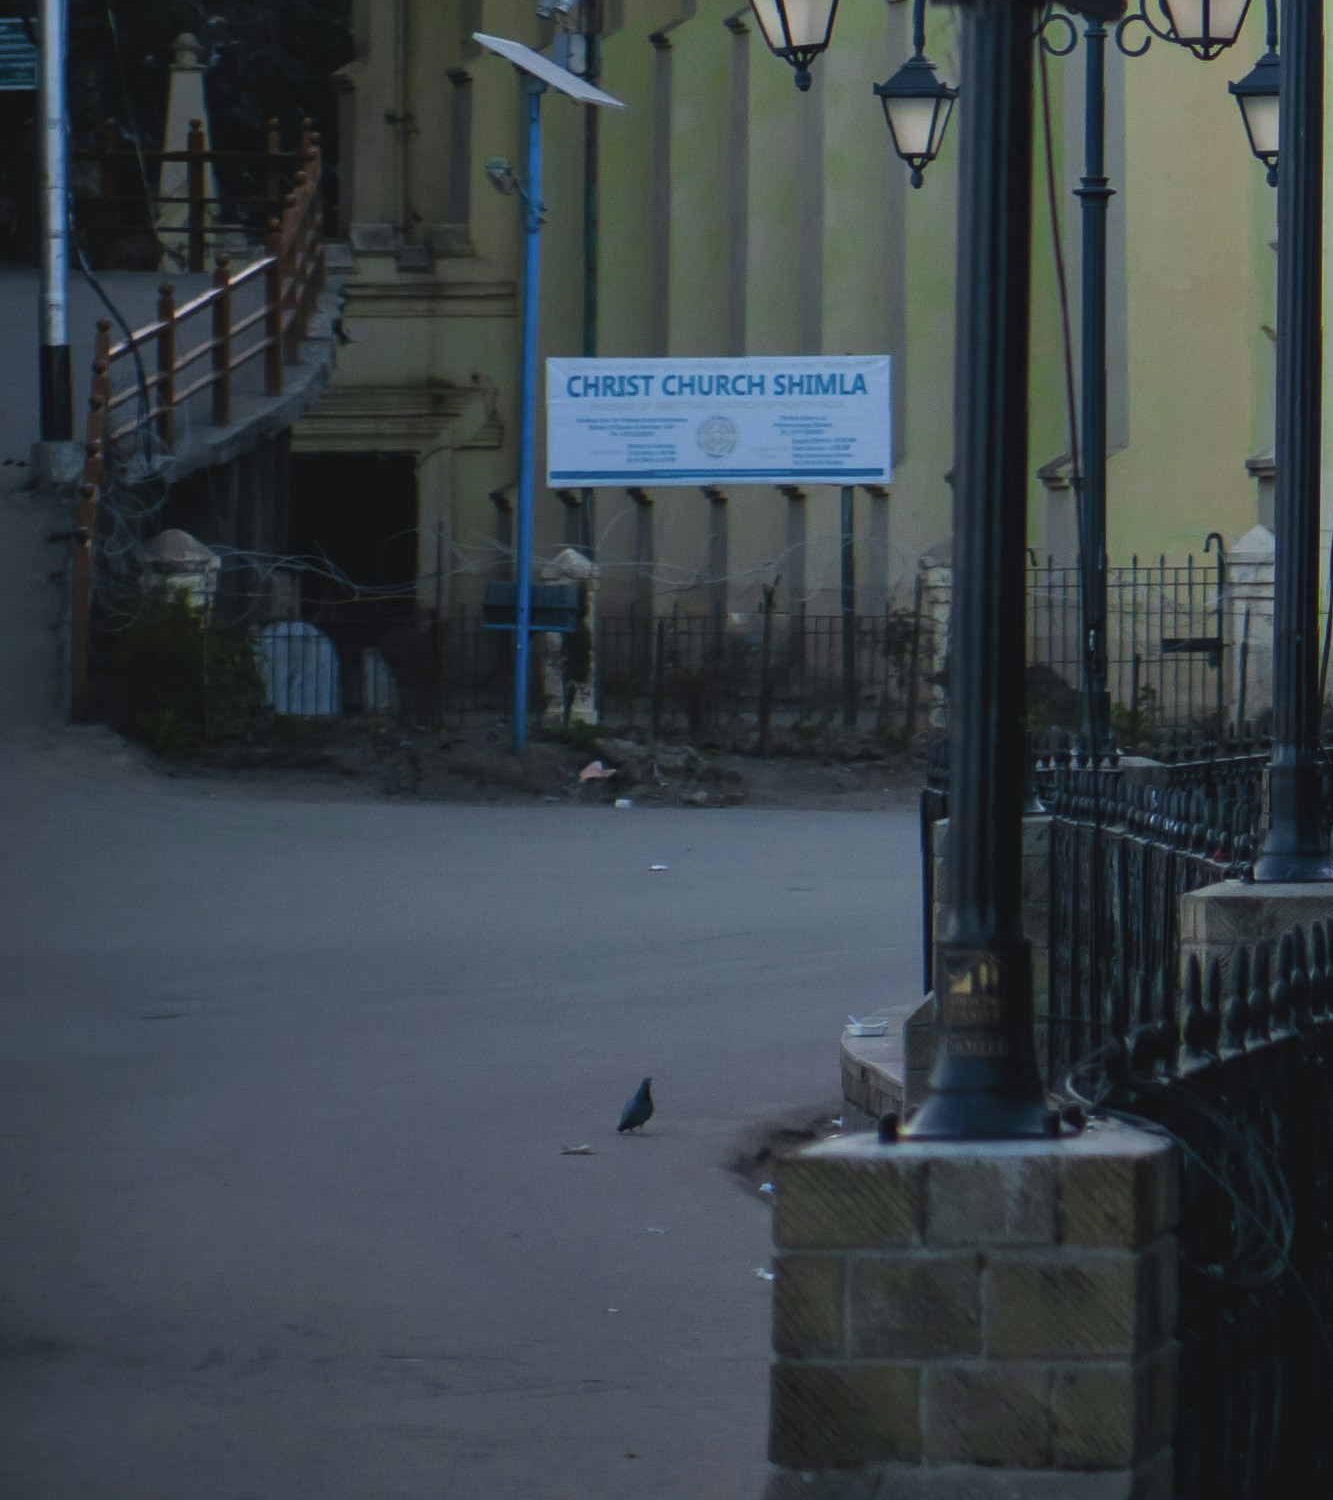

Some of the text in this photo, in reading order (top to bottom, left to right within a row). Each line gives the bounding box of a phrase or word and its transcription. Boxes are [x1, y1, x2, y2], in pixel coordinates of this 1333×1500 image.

[566, 373, 868, 397] CHRIST CHURCH SHIMLA
